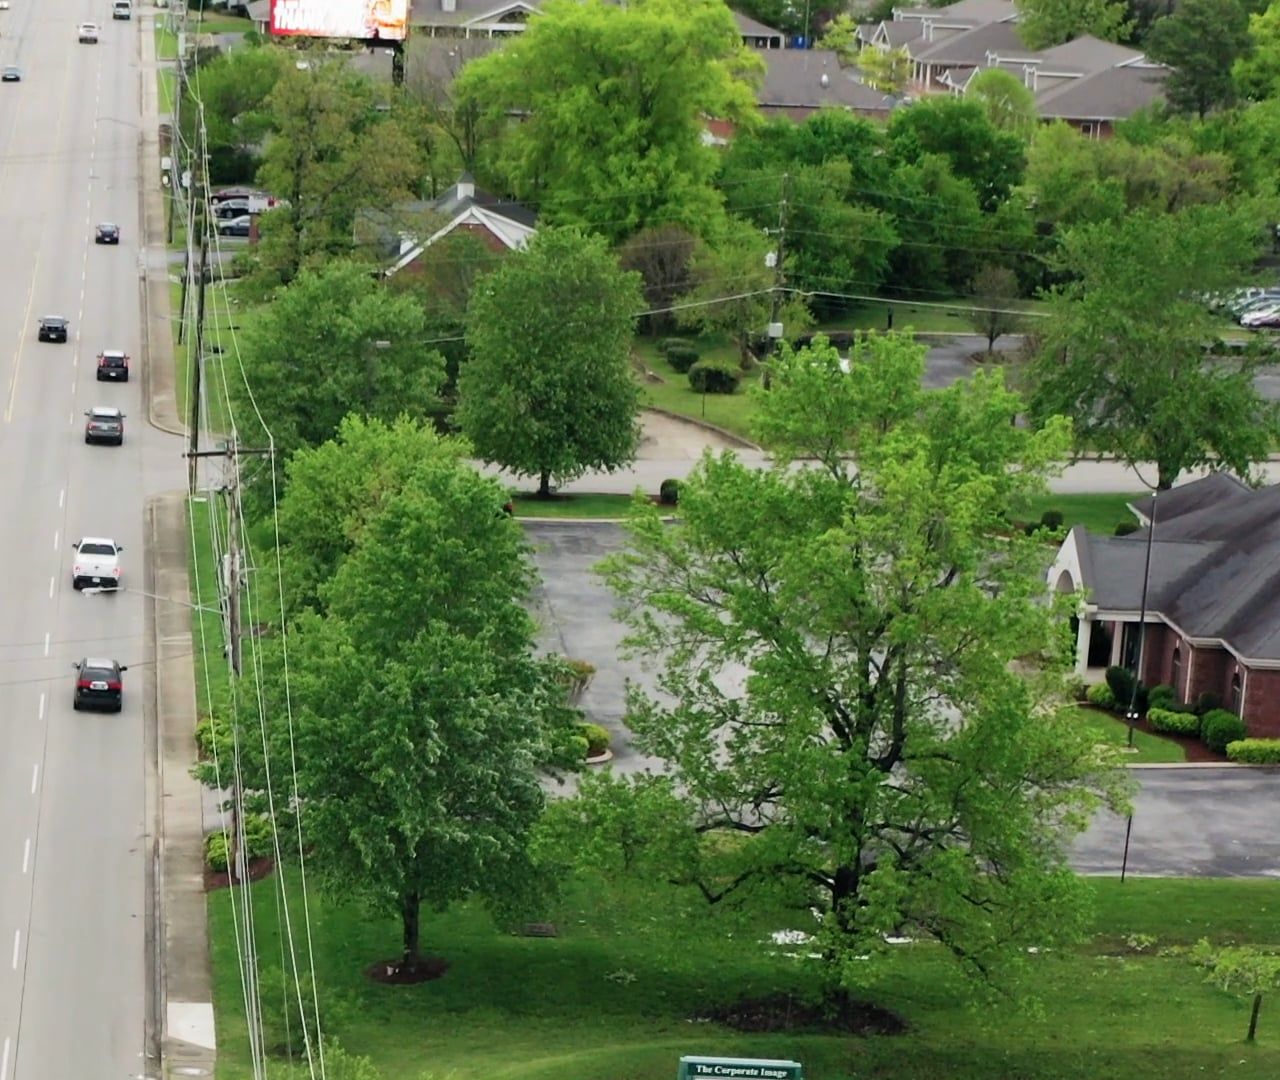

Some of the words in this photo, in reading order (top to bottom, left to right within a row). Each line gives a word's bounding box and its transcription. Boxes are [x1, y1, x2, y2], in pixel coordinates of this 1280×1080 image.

[696, 1065, 713, 1074] The
[714, 1065, 759, 1076] Corporate
[761, 1068, 787, 1079] Image
